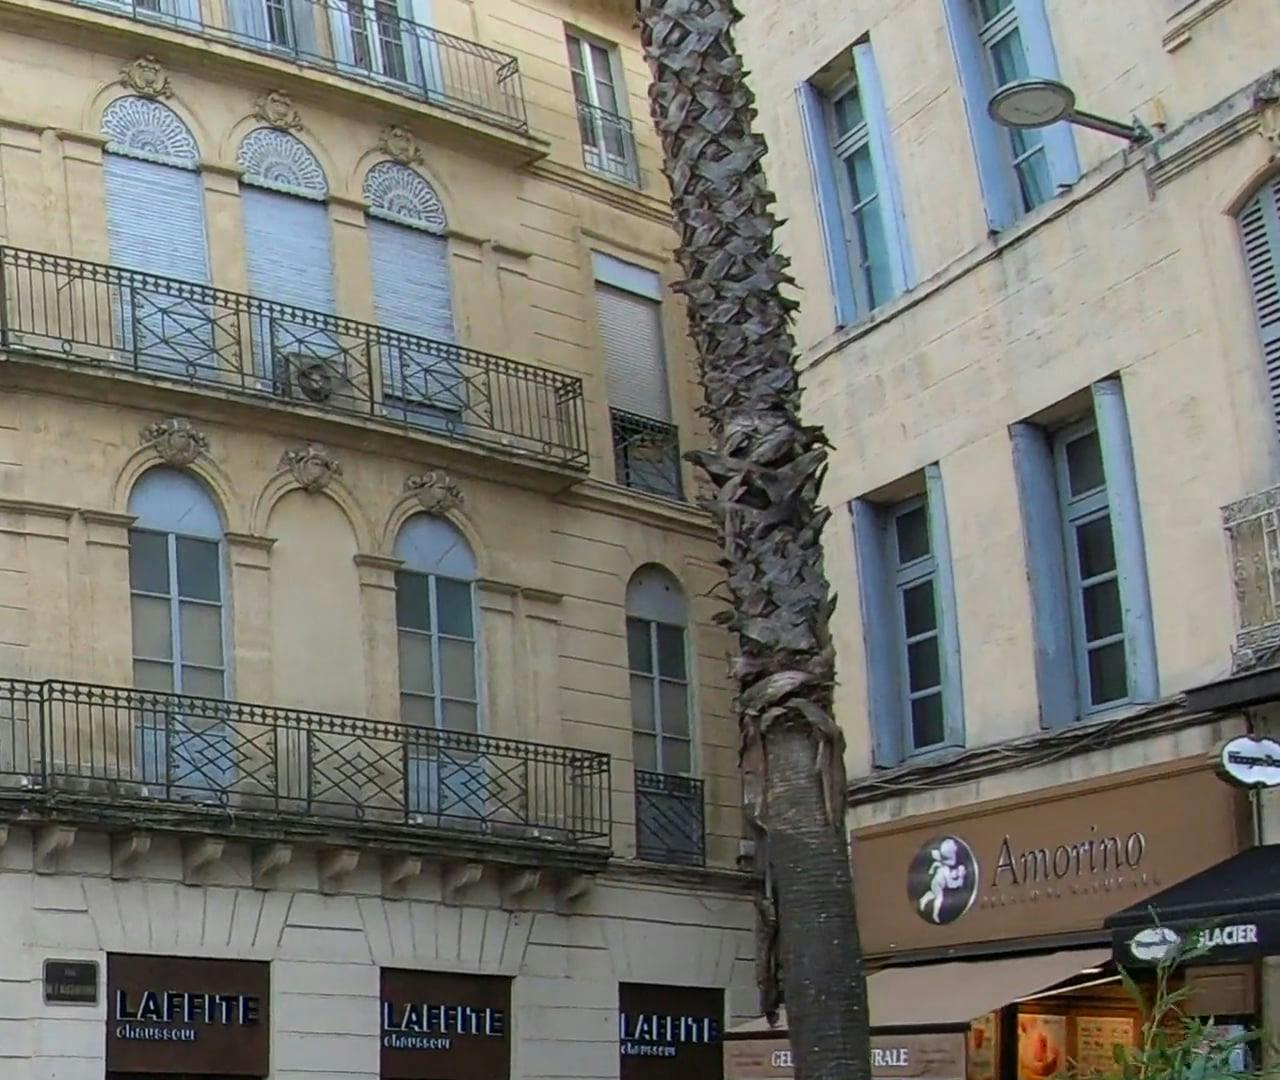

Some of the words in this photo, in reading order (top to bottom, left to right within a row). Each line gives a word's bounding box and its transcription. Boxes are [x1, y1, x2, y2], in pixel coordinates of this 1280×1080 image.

[991, 824, 1146, 887] Amorino
[116, 989, 261, 1025] LAFFITE
[383, 1001, 505, 1036] LAFFITE
[620, 1012, 719, 1043] LAFFITE
[771, 1050, 795, 1068] GEL
[873, 1048, 909, 1067] RALE
